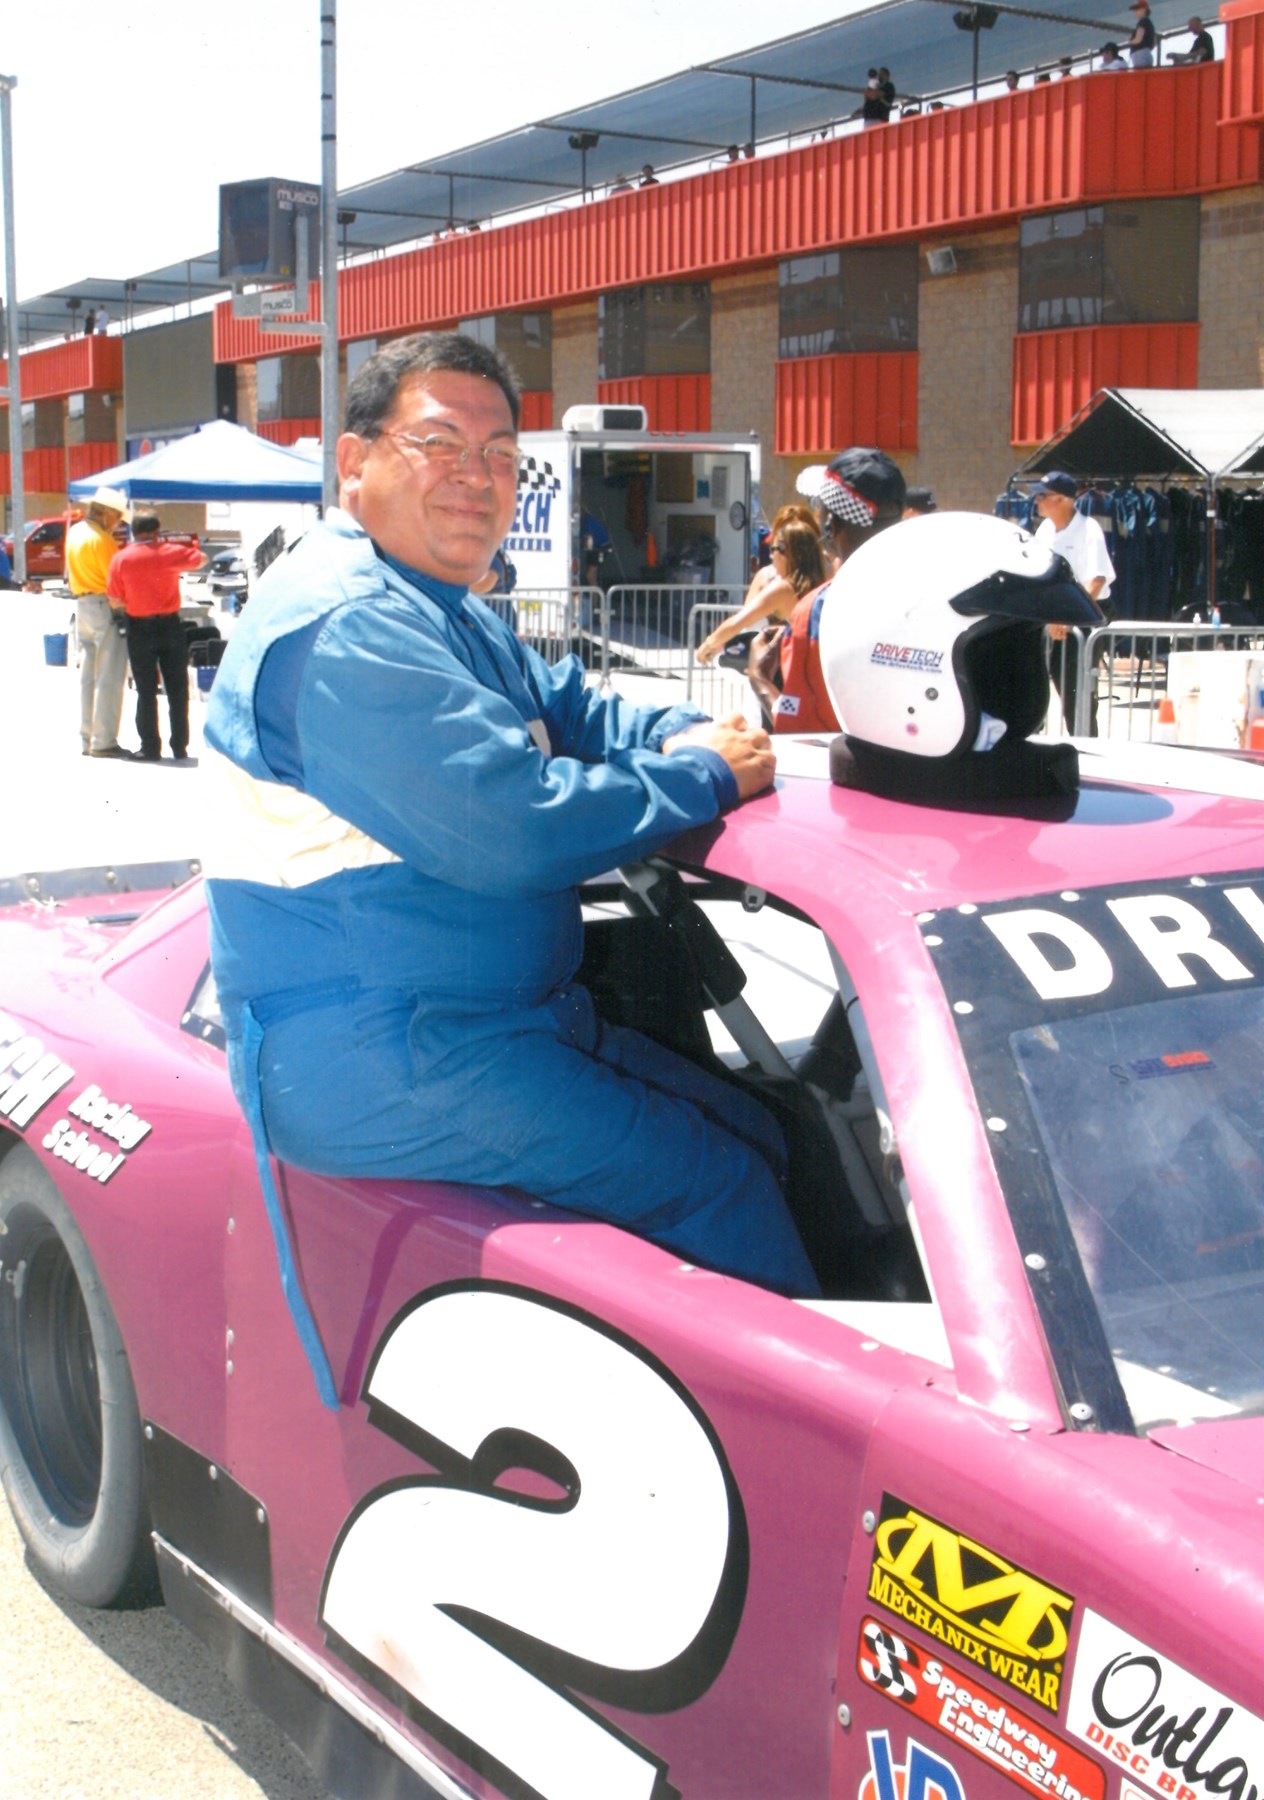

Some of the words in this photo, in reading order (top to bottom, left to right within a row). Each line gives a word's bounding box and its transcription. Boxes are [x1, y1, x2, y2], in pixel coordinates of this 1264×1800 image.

[873, 642, 944, 665] DRIVETECH
[42, 1119, 126, 1185] School
[320, 1284, 740, 1800] 2
[868, 1562, 988, 1665] MECHANIX
[984, 1649, 1060, 1712] WEAR
[921, 1658, 1057, 1769] Speedway
[938, 1697, 1091, 1800] Engineerin
[1085, 1721, 1150, 1775] DISC
